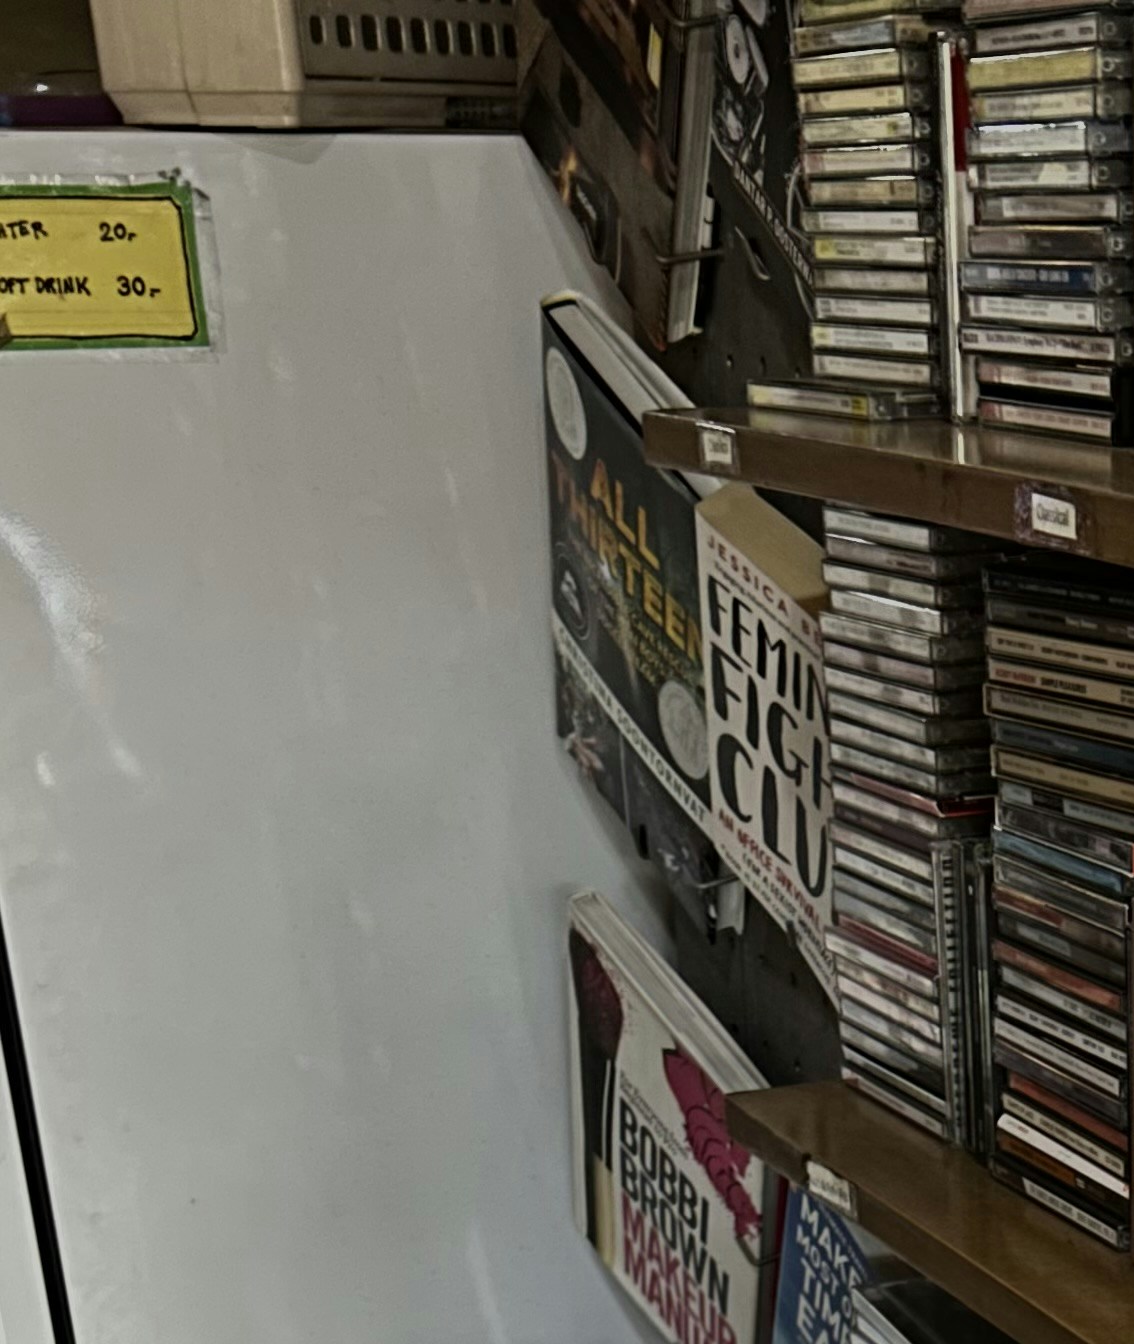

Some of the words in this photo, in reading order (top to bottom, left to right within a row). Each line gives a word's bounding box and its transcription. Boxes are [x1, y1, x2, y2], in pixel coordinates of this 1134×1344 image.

[36, 277, 91, 297] DRINK
[553, 451, 703, 663] THIRTEEN
[590, 459, 660, 571] ALL
[619, 1097, 709, 1246] BOBBI
[619, 1146, 729, 1317] BROWN
[800, 1193, 864, 1291] MAKE
